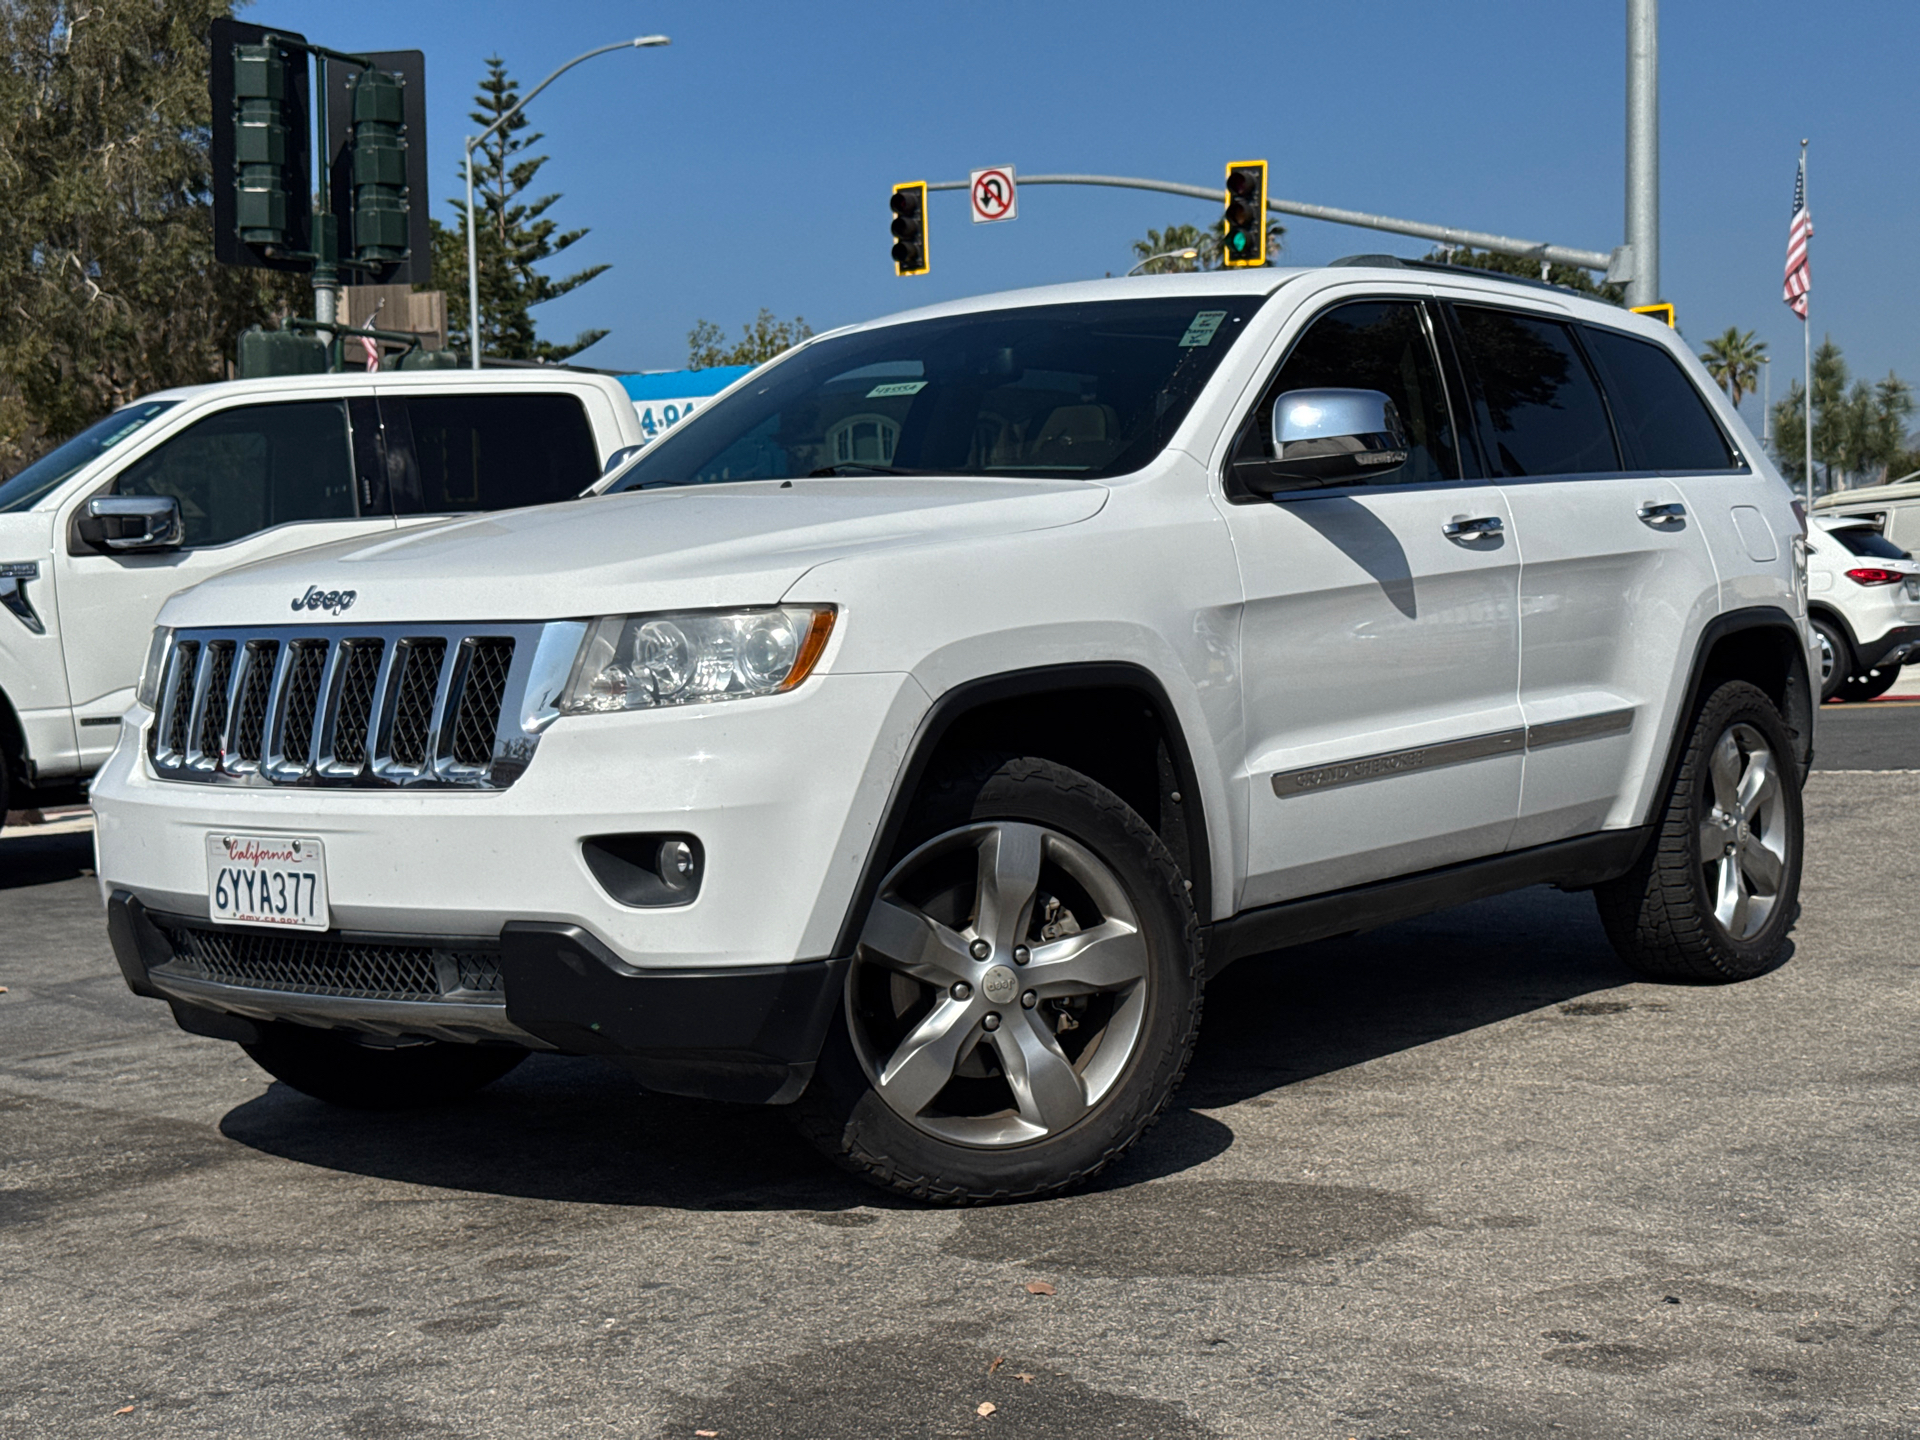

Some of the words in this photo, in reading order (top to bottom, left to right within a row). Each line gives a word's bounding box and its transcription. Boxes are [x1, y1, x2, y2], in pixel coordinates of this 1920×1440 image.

[291, 584, 357, 616] Jeep
[1296, 764, 1349, 787] GRAND
[1353, 749, 1426, 776] CHEROKEE
[229, 839, 302, 867] California
[215, 867, 316, 917] 6YYA377
[986, 977, 1016, 992] Jeep
